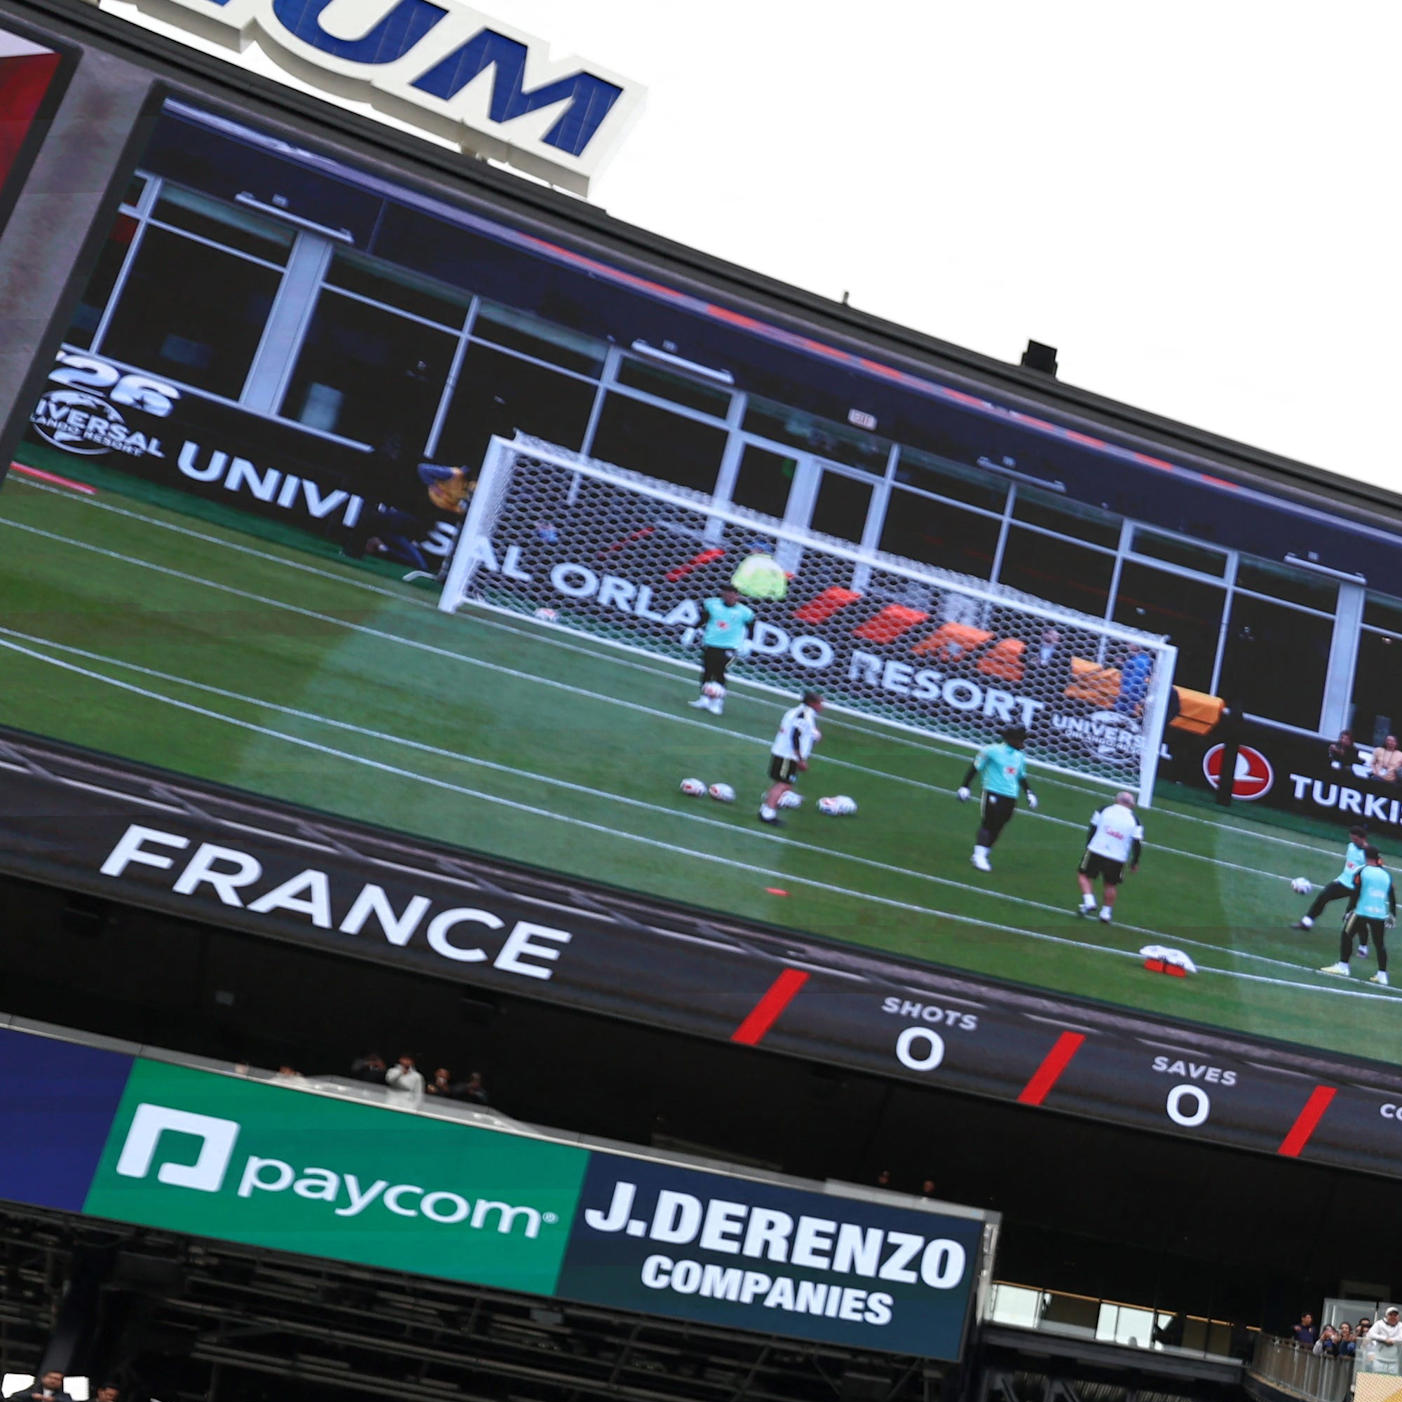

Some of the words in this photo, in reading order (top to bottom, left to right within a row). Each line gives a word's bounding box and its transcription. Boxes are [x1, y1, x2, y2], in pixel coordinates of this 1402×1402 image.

[550, 562, 834, 668] ORLADO
[850, 650, 1044, 729] RESORT
[100, 823, 571, 980] FRANCE
[881, 996, 978, 1033] SHOTS
[1152, 1055, 1238, 1087] SAVES
[641, 1254, 893, 1327] COMPANIES
